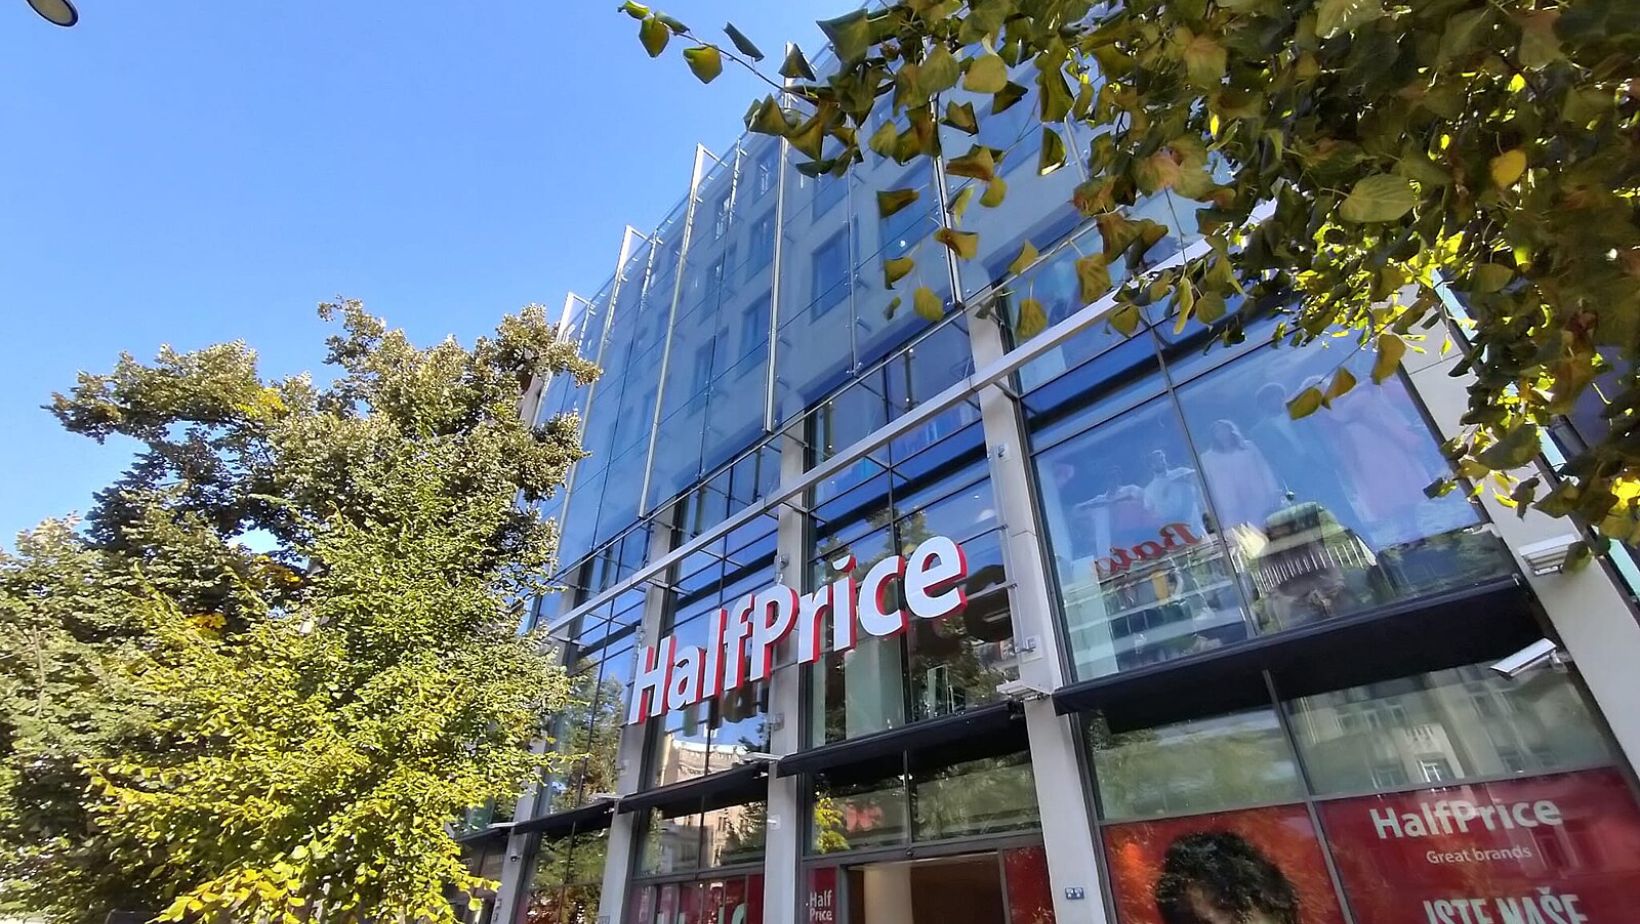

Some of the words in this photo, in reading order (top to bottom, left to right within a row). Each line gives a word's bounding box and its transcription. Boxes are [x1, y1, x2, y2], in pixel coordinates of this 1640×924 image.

[628, 536, 968, 725] HalfPrice
[1369, 800, 1562, 839] HalfPrice
[1426, 850, 1471, 864] Great
[1474, 845, 1533, 861] brands
[810, 890, 832, 907] Half
[810, 908, 833, 922] Price
